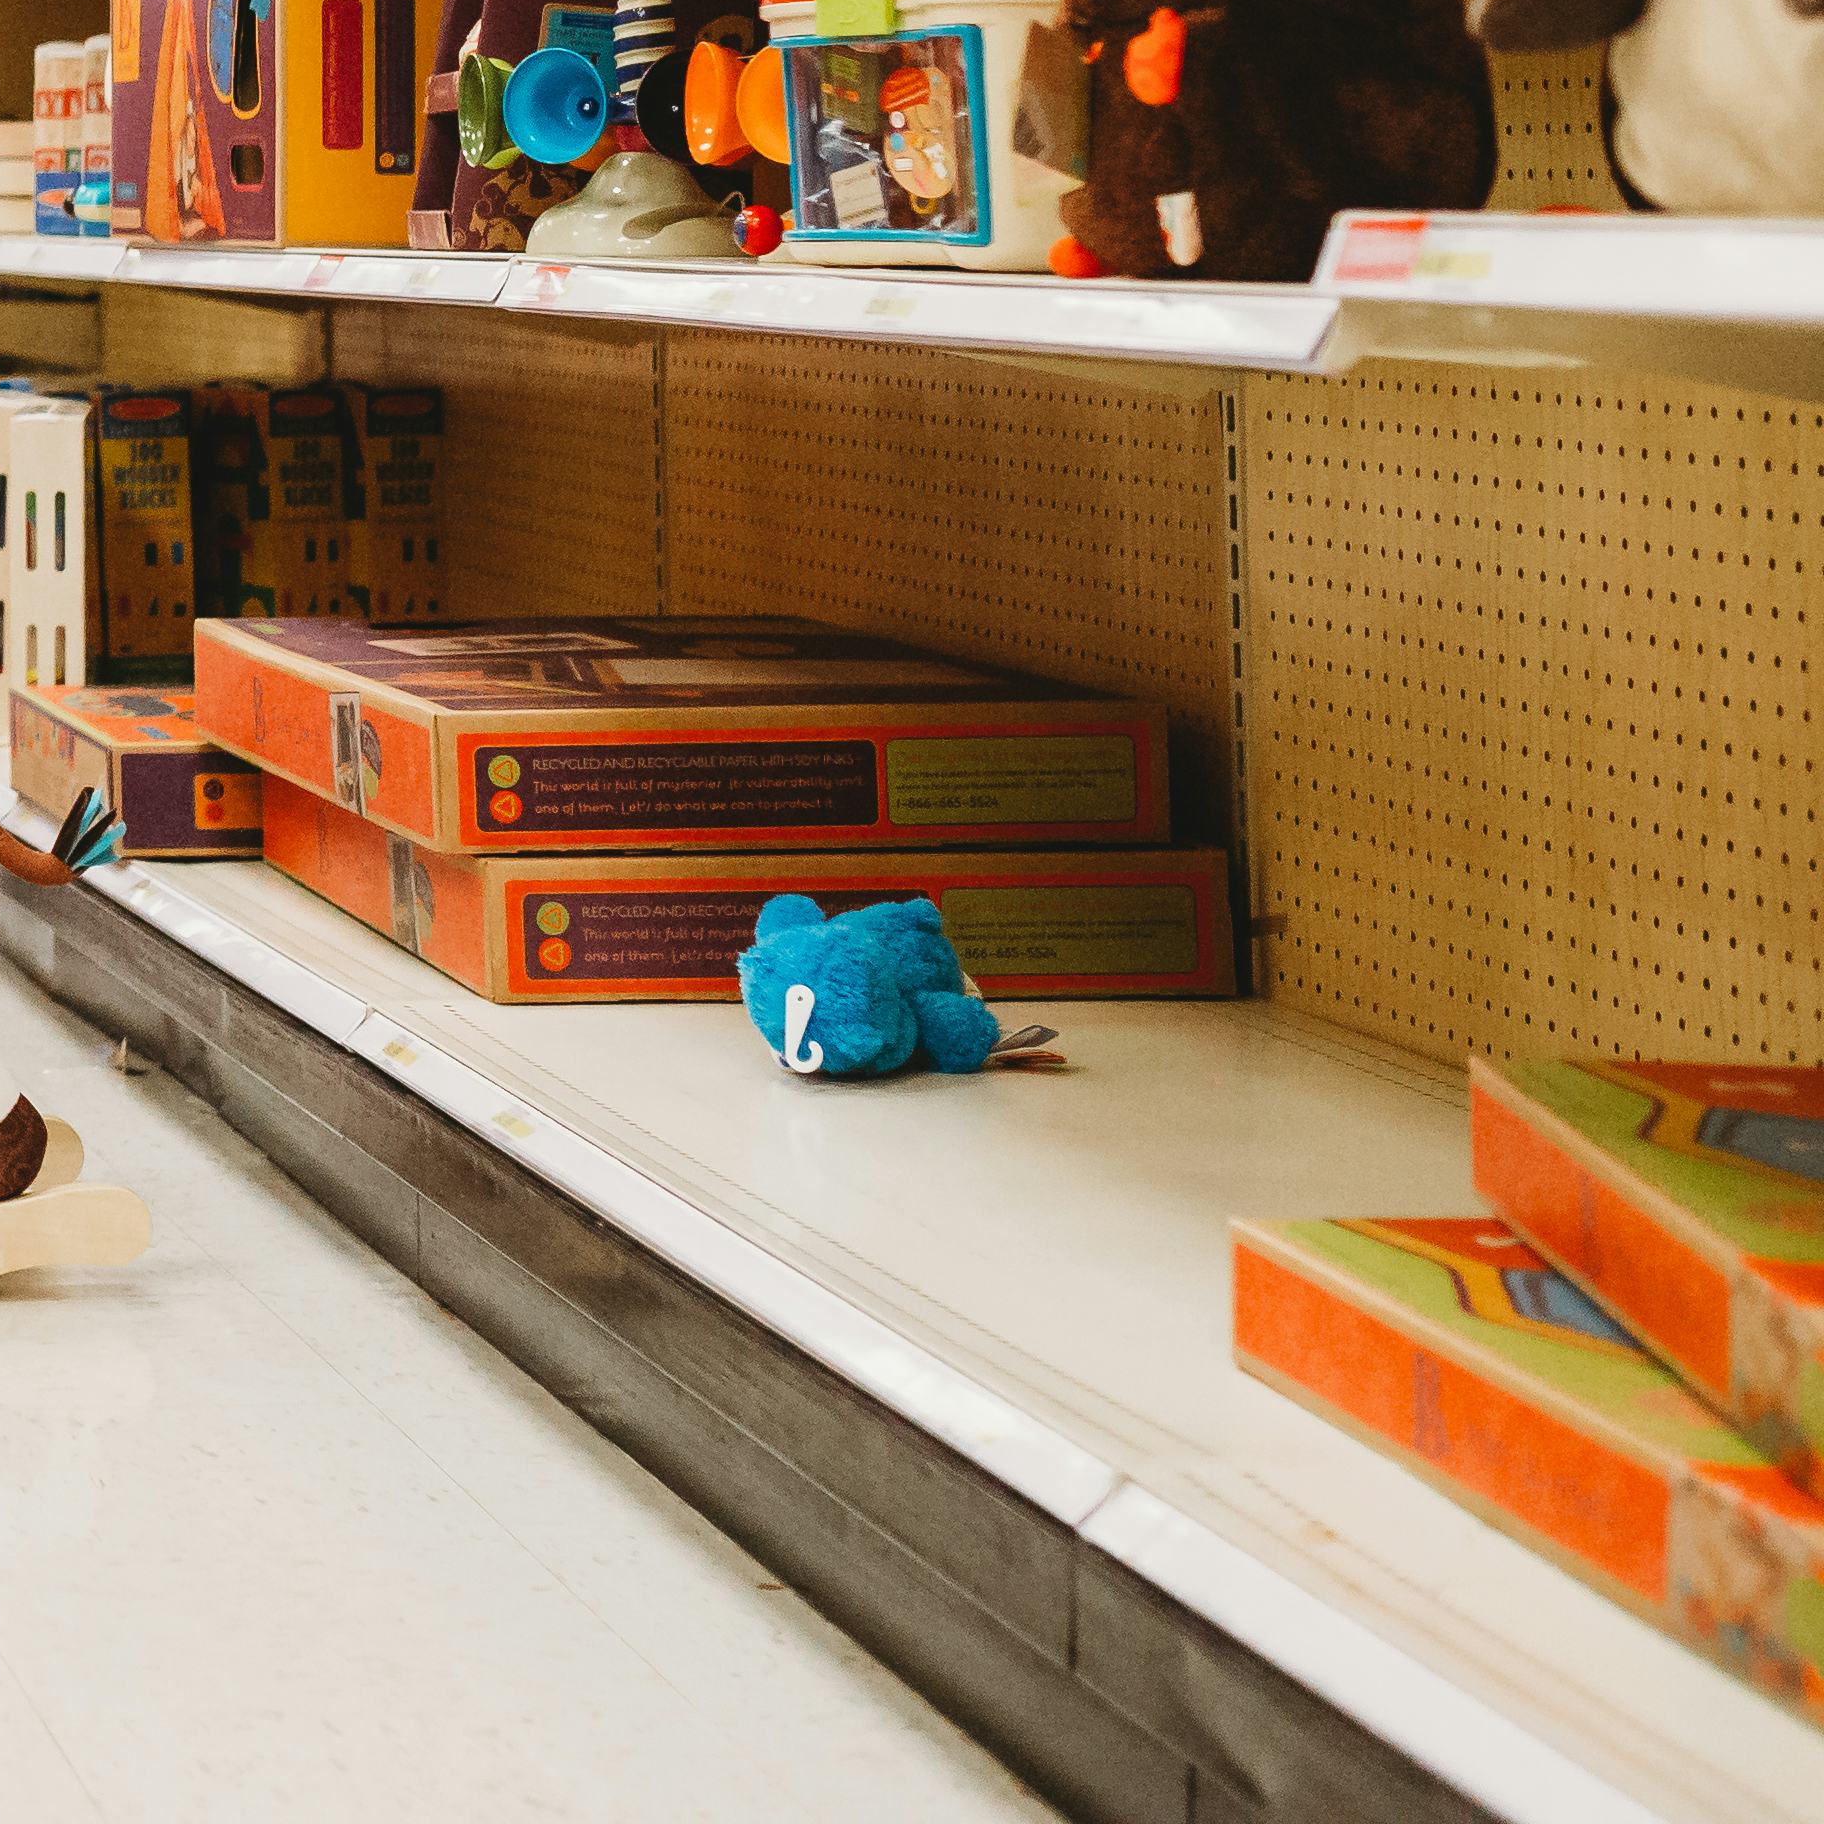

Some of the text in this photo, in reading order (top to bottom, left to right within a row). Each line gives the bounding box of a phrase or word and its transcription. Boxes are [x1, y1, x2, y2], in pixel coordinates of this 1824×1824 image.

[532, 758, 601, 771] RECYCLED
[602, 757, 635, 769] AND
[533, 781, 558, 792] This
[560, 780, 600, 792] world
[615, 779, 639, 793] full
[641, 779, 654, 793] of
[535, 804, 560, 814] one
[562, 802, 575, 816] of
[654, 802, 672, 812] do
[673, 801, 707, 812] what
[709, 802, 727, 811] we
[731, 802, 754, 811] can
[757, 800, 771, 810] to
[773, 799, 821, 813] protect
[581, 904, 688, 918] RECYCLED AND
[583, 927, 608, 940] This
[611, 927, 649, 940] world
[692, 926, 704, 942] of
[584, 953, 608, 962] one
[611, 951, 625, 964] of
